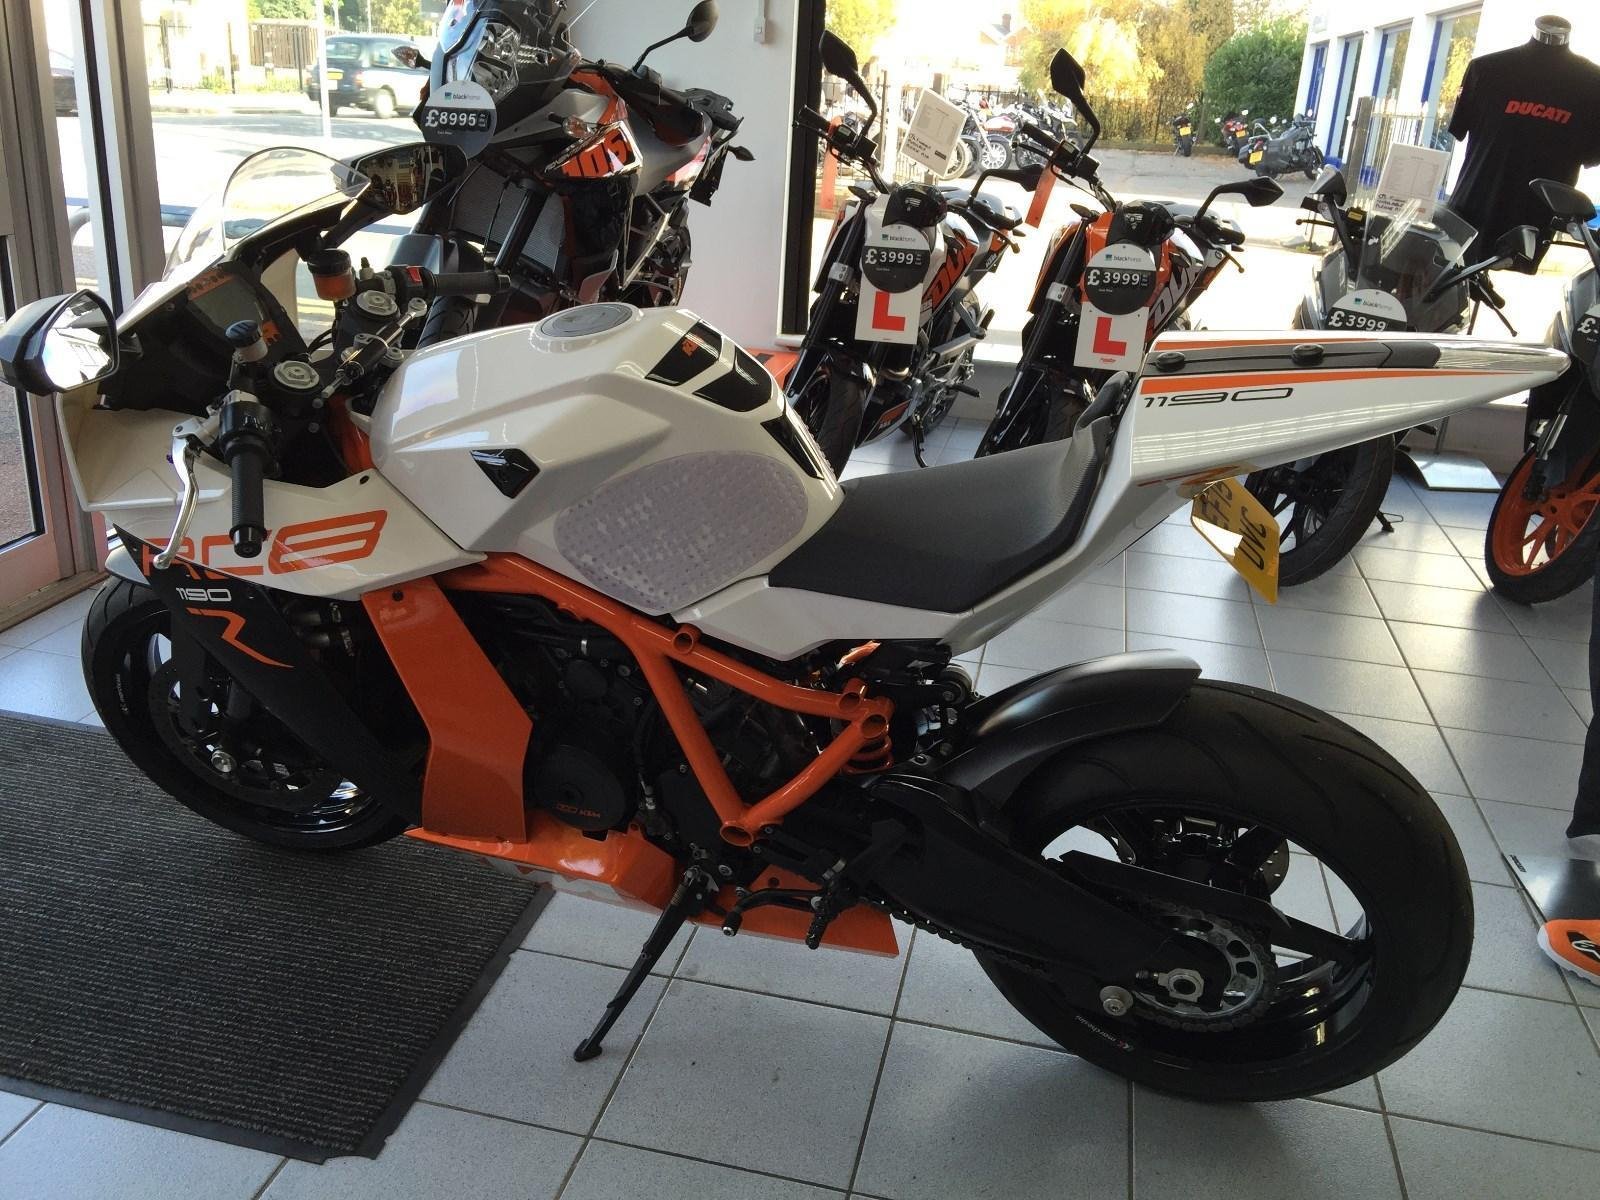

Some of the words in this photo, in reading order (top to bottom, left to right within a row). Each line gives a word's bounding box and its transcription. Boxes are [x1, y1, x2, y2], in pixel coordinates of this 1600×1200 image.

[425, 109, 477, 127] £8995
[1504, 100, 1572, 123] DUCATI
[865, 248, 914, 265] £3999
[1087, 269, 1140, 286] £3999
[872, 290, 906, 332] L
[1092, 316, 1127, 357] L
[1144, 387, 1293, 408] 1190
[175, 587, 232, 602] 1190
